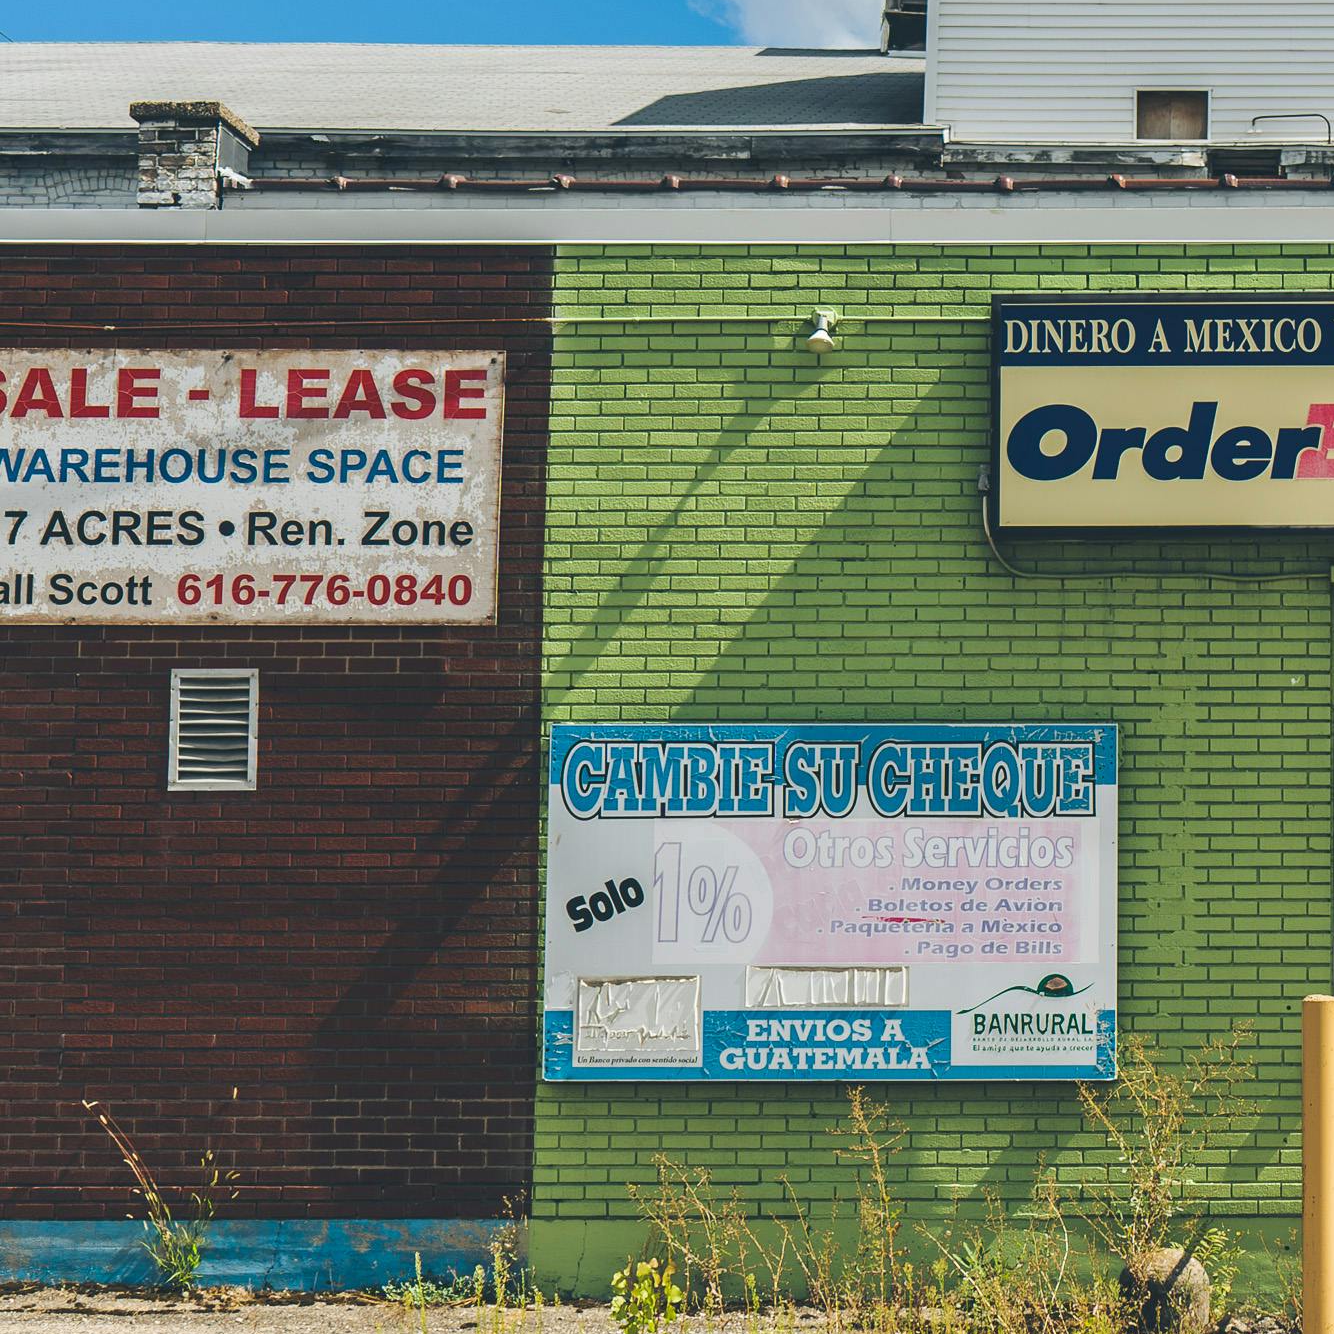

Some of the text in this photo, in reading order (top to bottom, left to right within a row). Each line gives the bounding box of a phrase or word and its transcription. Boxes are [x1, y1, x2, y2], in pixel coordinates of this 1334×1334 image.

[1003, 317, 1137, 354] DINERO
[1147, 317, 1173, 353] A
[1184, 317, 1323, 354] MEXICO
[0, 366, 161, 418] ALE
[239, 368, 488, 419] LEASE
[306, 449, 465, 484] SPACE
[4, 510, 475, 547] 7 ACRES Ren. Zone
[48, 574, 153, 605] Scott
[177, 574, 473, 606] 616-776-0840
[561, 739, 1096, 820] CAMBIE SU CHEQUE
[783, 827, 1074, 868] Otros Servicios
[653, 841, 752, 943] 1%
[901, 877, 1062, 894] Money Orders
[868, 898, 953, 912] Boletos
[960, 898, 988, 912] de
[961, 923, 974, 934] a
[917, 941, 1062, 958] Pago de Bills
[746, 1019, 906, 1042] ENVIOS A
[973, 1013, 1094, 1035] BANRURAL
[588, 1056, 610, 1064] Banco
[611, 1056, 637, 1065] privado
[652, 1056, 677, 1064] sentido
[678, 1056, 698, 1064] social
[719, 1047, 932, 1069] GUATEMALA
[982, 1044, 1006, 1054] amigo
[1009, 1045, 1024, 1054] que
[1026, 1044, 1034, 1052] te
[1036, 1044, 1060, 1054] ayuda
